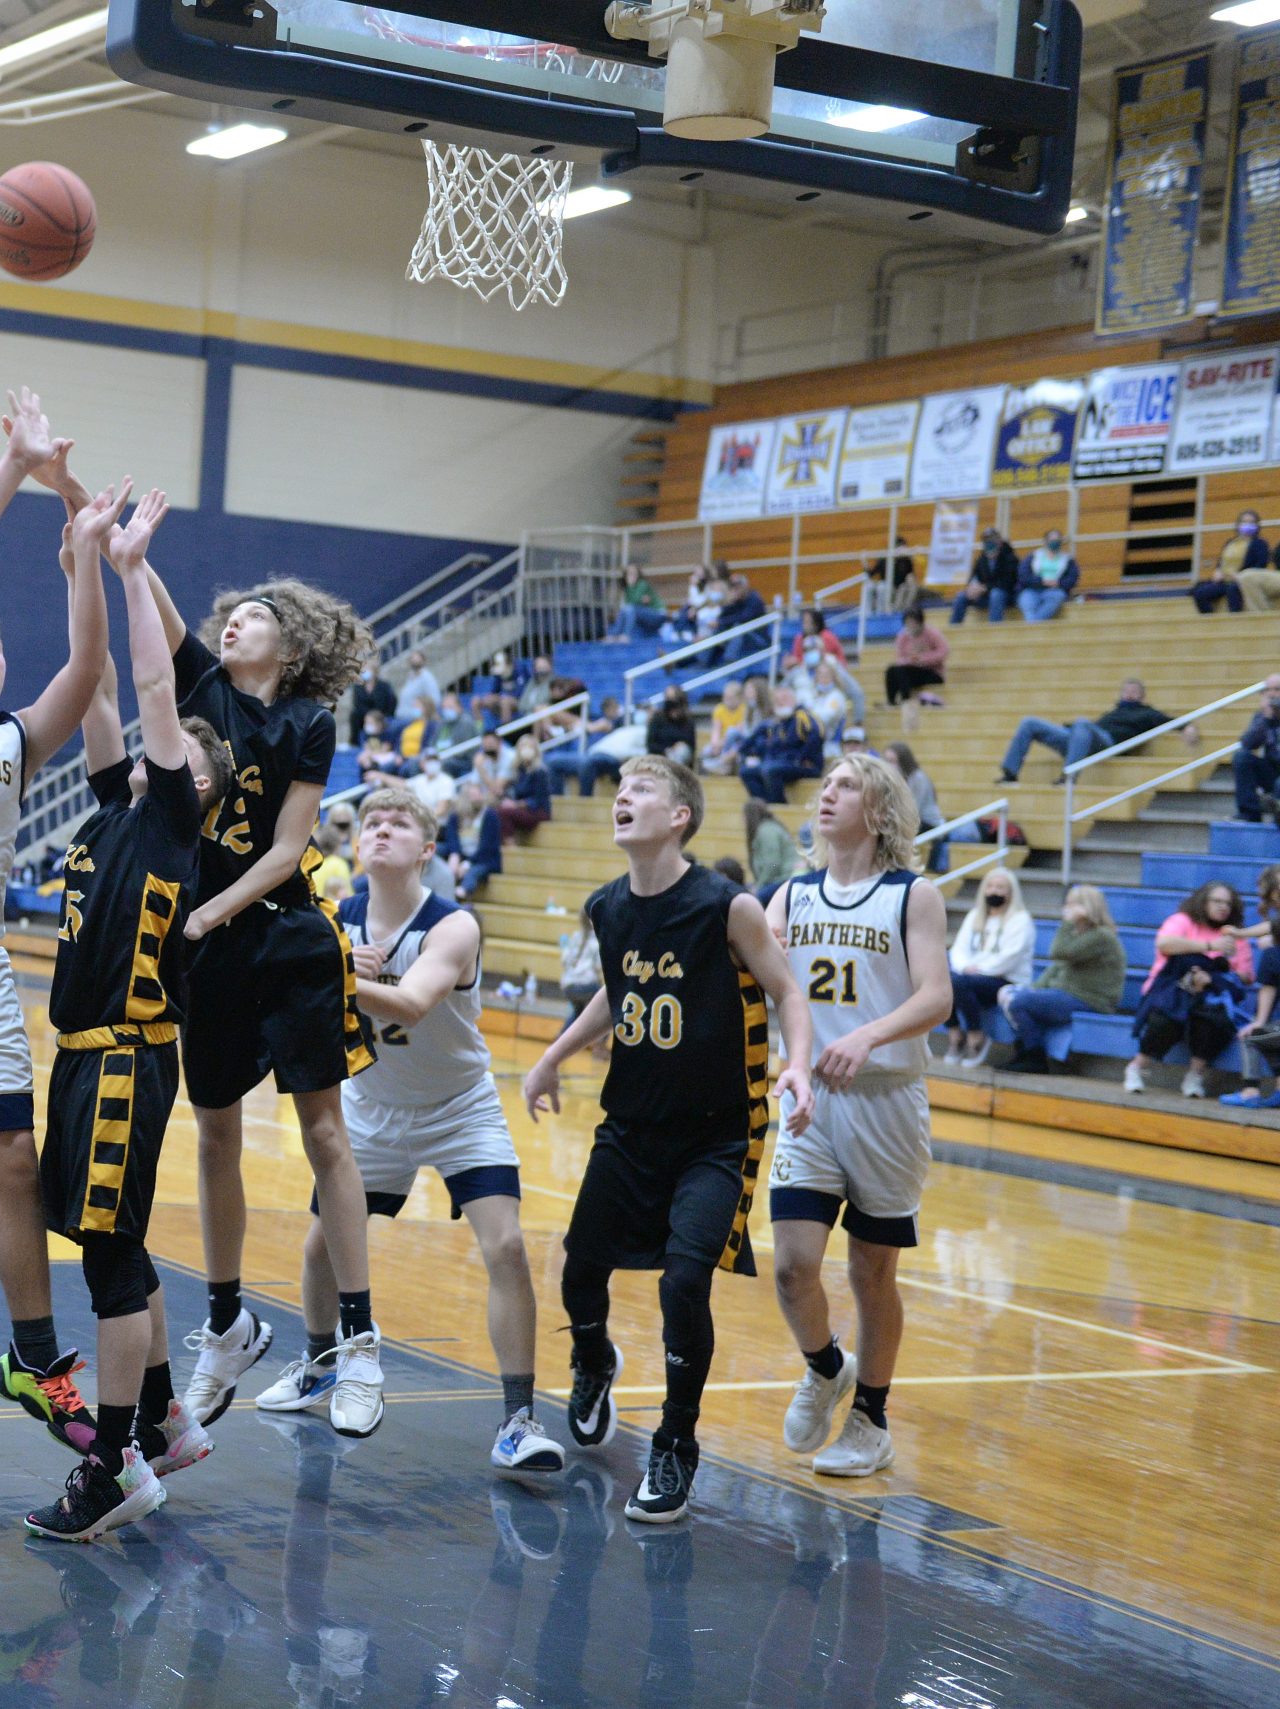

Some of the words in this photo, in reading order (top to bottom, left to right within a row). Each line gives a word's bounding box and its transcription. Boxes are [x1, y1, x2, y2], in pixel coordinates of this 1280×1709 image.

[1185, 357, 1275, 390] SAV-RITE
[1135, 375, 1178, 424] ICE
[1006, 433, 1063, 459] OFFICE
[789, 922, 890, 955] PANTHERS
[622, 949, 656, 984] Clay
[808, 956, 859, 1006] 21
[614, 991, 684, 1050] 30
